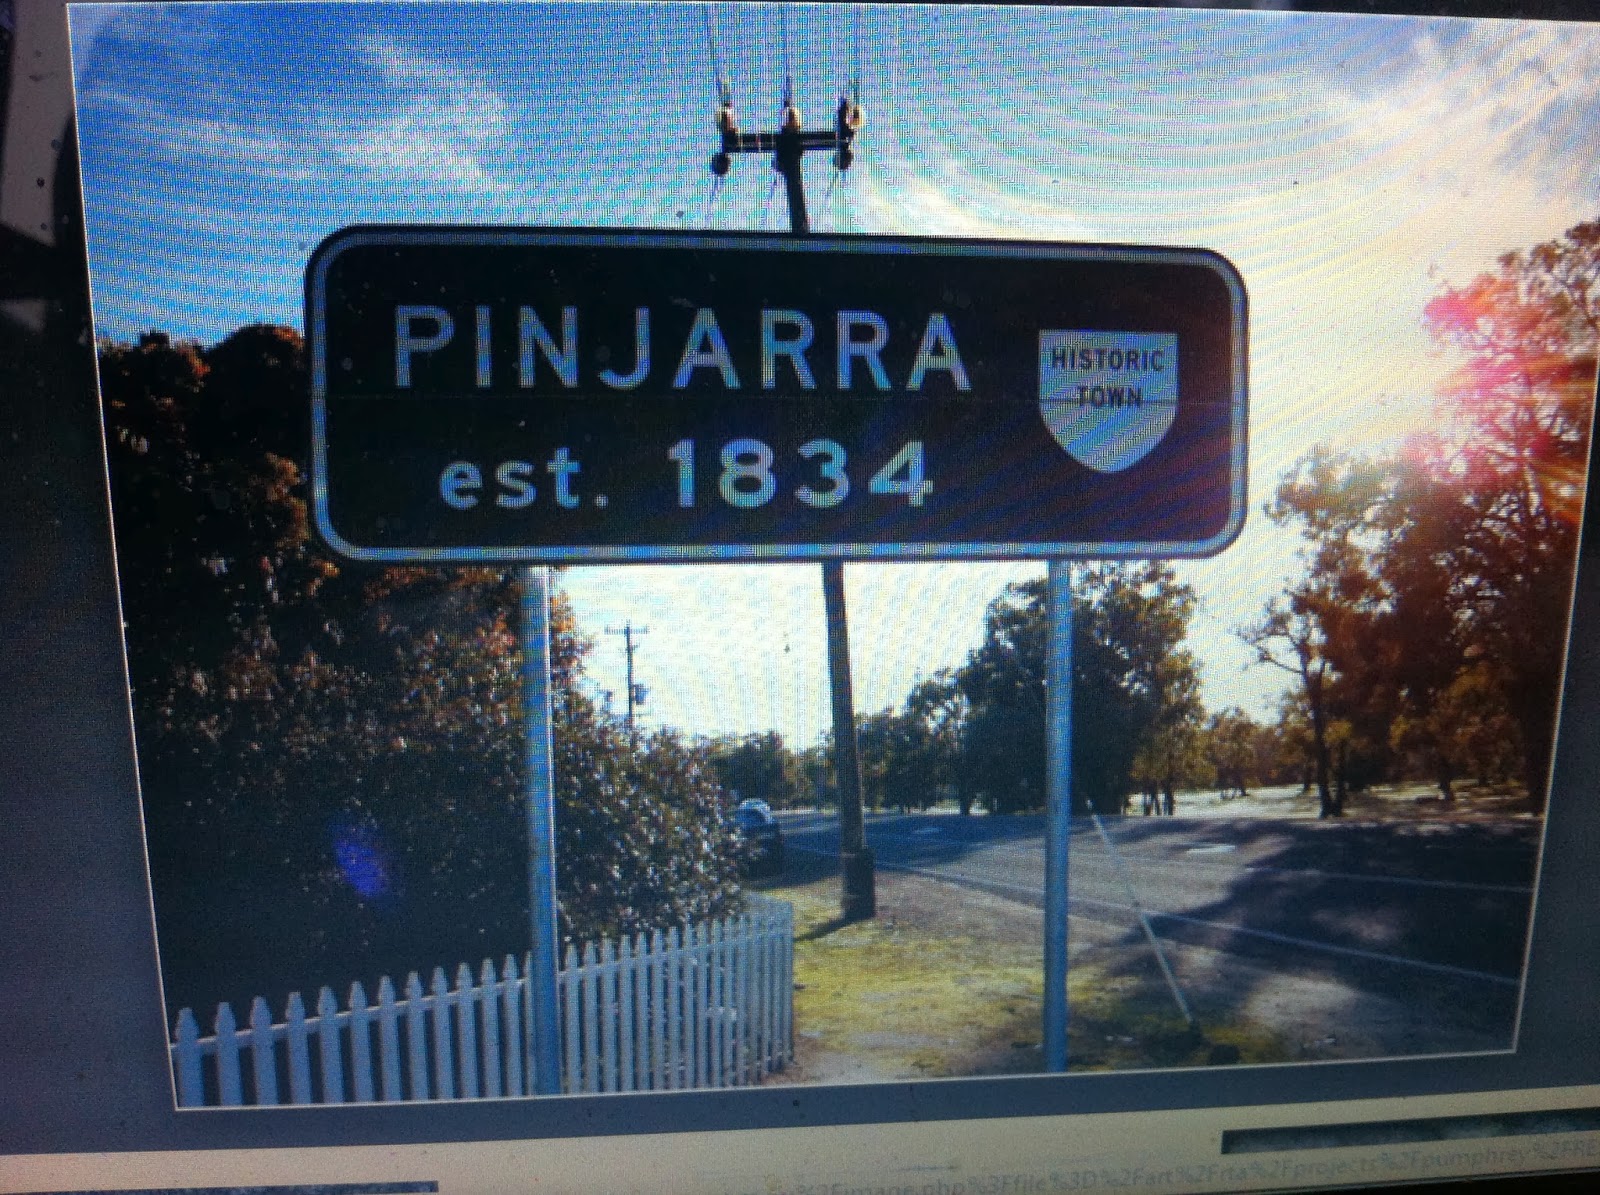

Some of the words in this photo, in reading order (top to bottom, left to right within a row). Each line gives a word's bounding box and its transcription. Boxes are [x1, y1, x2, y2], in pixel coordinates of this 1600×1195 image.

[394, 304, 972, 392] PINJARRA
[1051, 348, 1165, 372] HISTORIC
[1077, 385, 1142, 407] TOWN
[438, 446, 609, 510] est.
[667, 438, 934, 509] 1834
